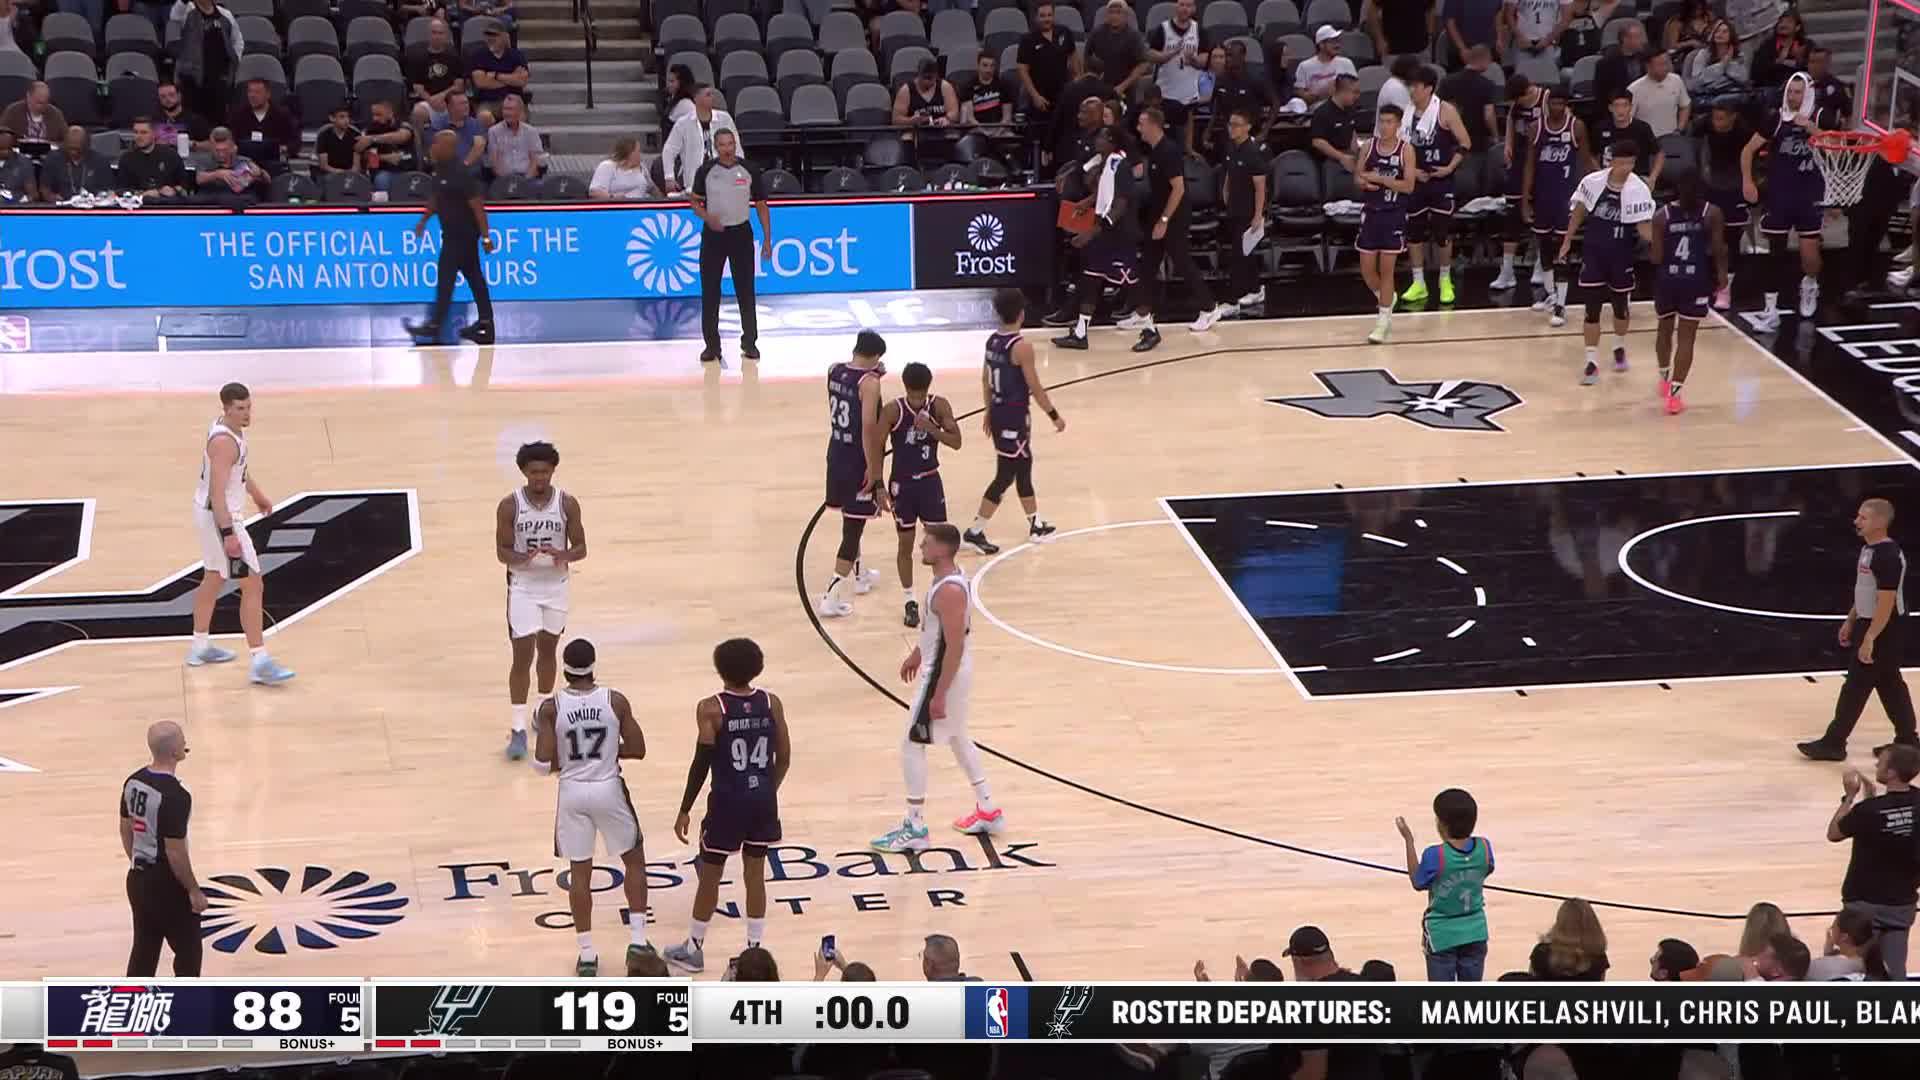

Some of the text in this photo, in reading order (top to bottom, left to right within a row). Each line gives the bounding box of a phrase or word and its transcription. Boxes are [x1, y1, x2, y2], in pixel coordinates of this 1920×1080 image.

[1425, 149, 1441, 162] 24
[200, 232, 257, 257] THE
[265, 228, 392, 257] OFFICIAL
[403, 229, 443, 255] BA
[528, 227, 579, 253] THE
[722, 227, 859, 278] rost
[1675, 235, 1690, 260] 4
[0, 239, 127, 290] rost
[249, 263, 305, 290] SAN
[314, 261, 439, 289] ANTONIO
[954, 251, 1016, 275] Frost
[831, 395, 850, 428] 23
[921, 444, 930, 460] 3
[517, 520, 562, 534] SPURS
[566, 708, 603, 725] UMUDE
[565, 726, 608, 761] 17
[731, 735, 769, 772] 94
[130, 787, 148, 817] 18
[765, 831, 1057, 883] Bank
